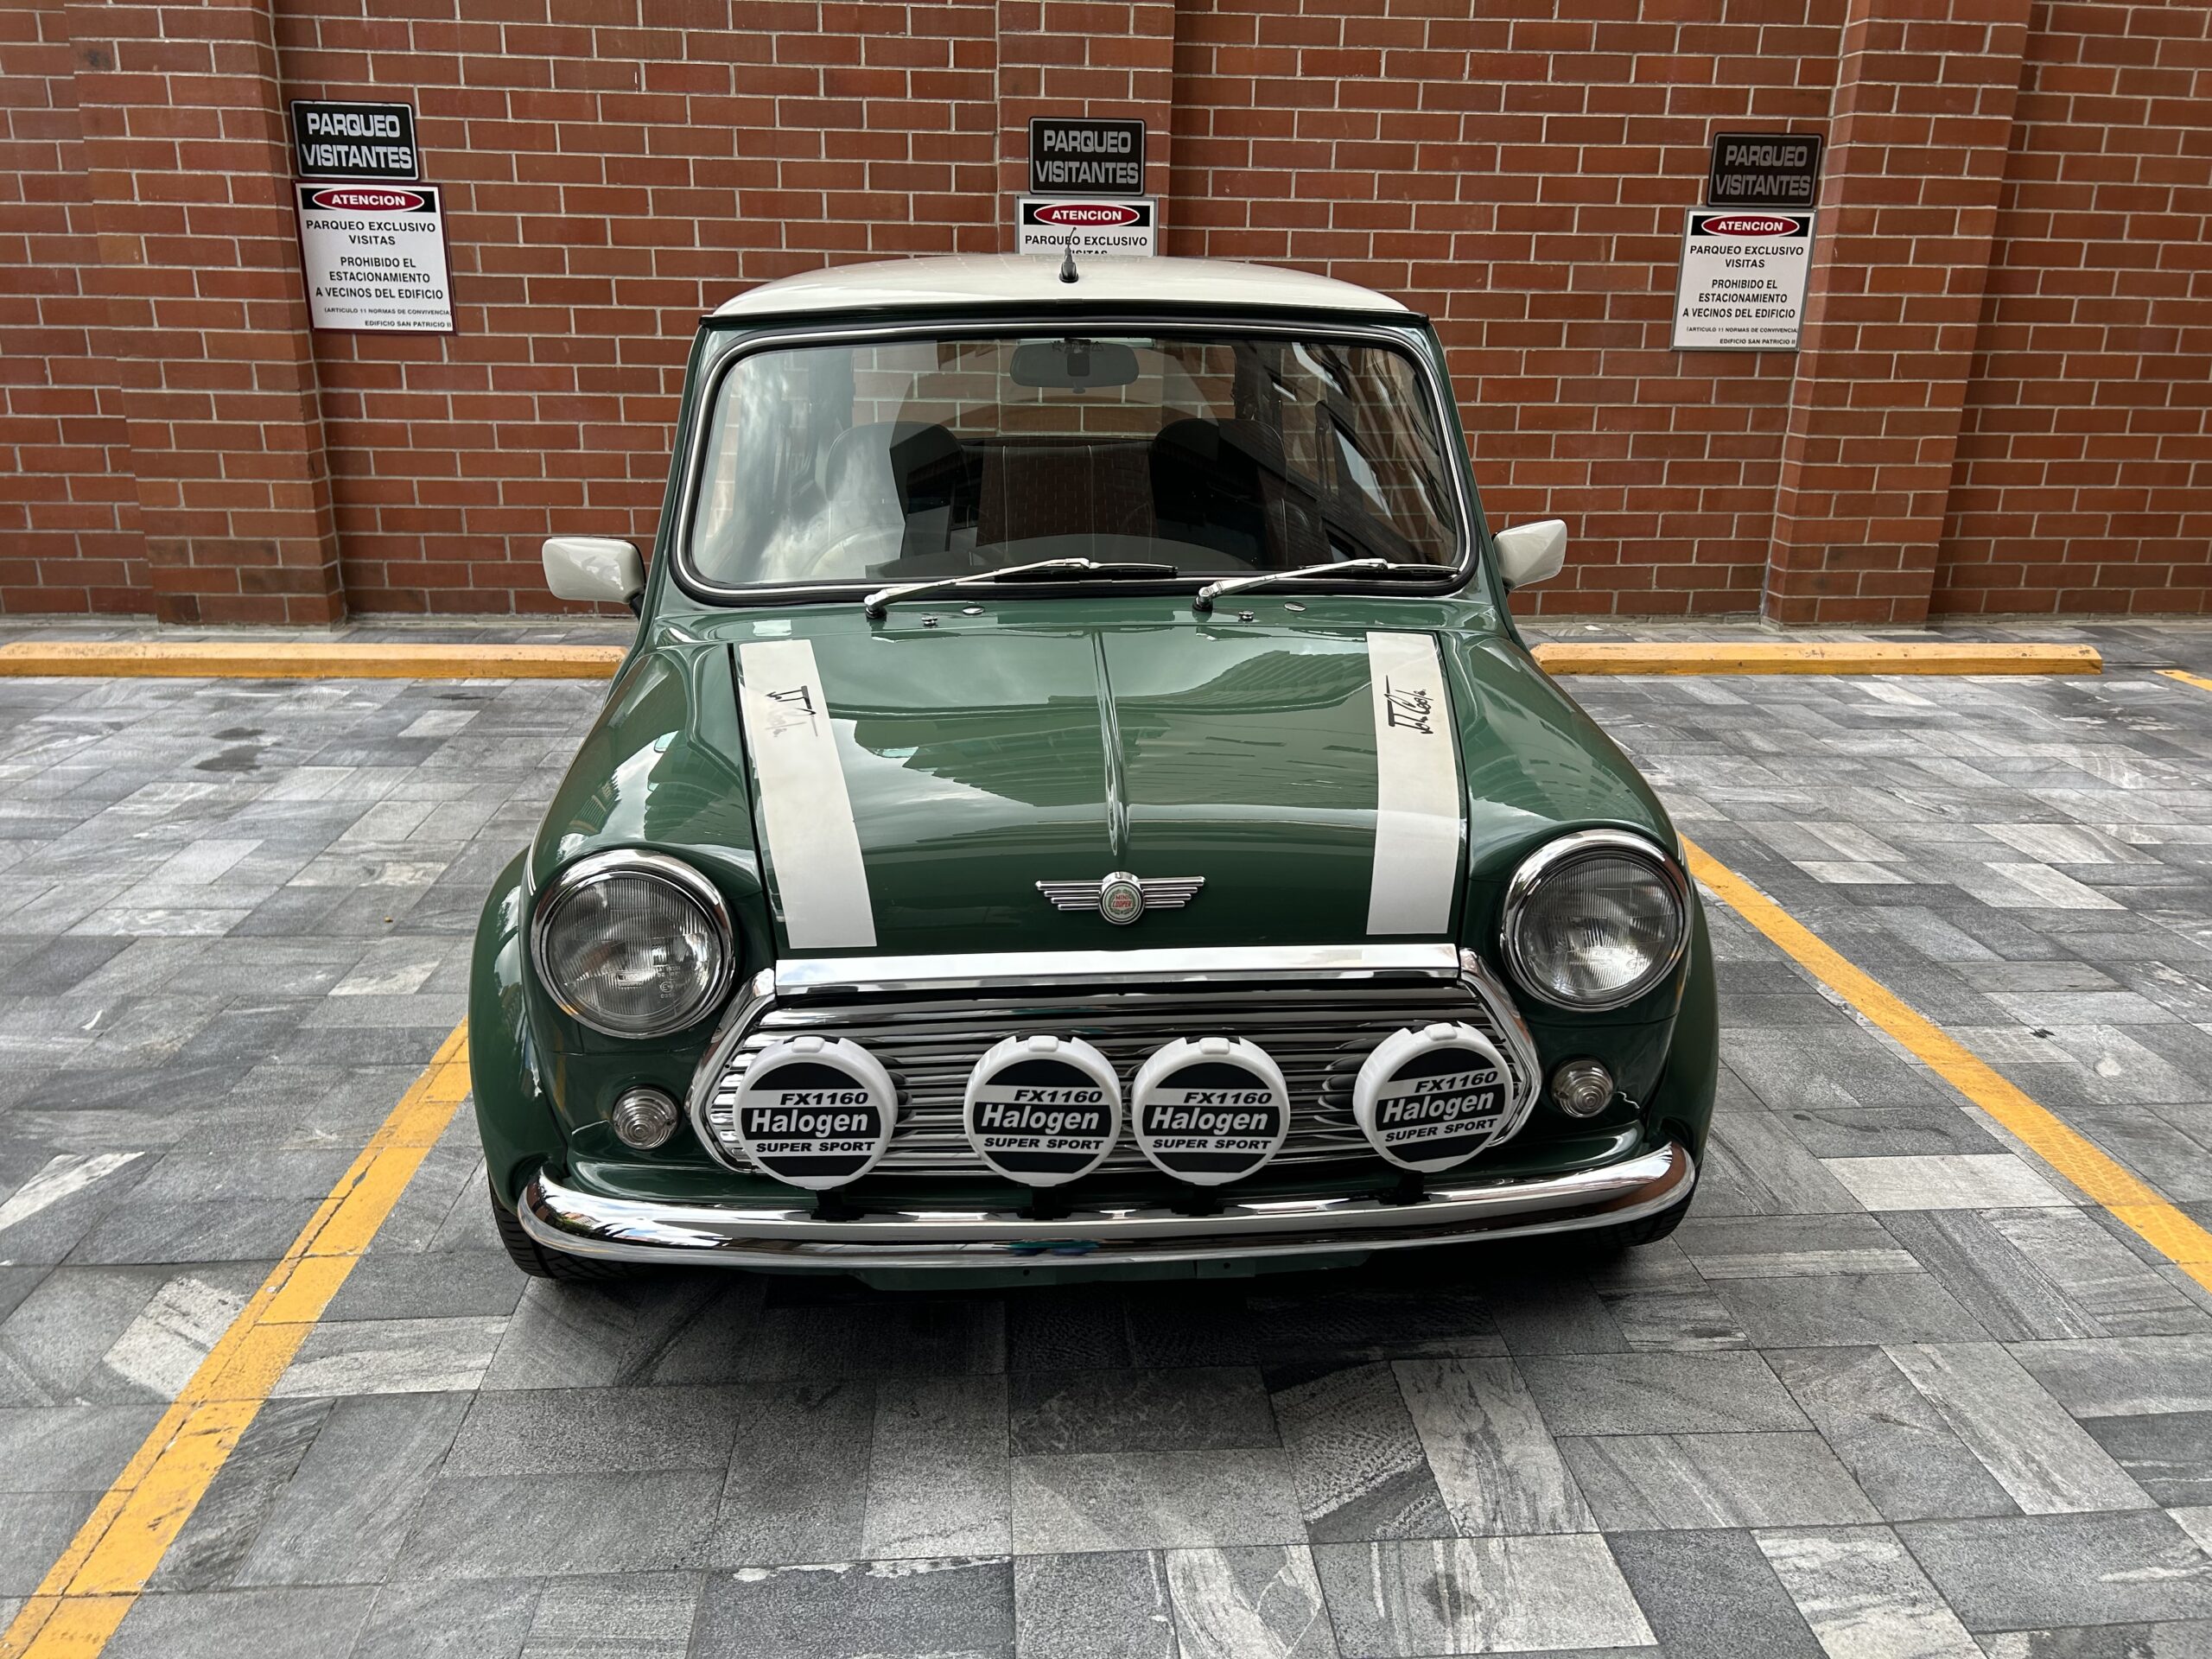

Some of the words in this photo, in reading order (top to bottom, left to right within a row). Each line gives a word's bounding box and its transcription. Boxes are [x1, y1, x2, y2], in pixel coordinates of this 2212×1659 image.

[307, 112, 400, 137] PARQUEO
[1044, 130, 1131, 153] PARQUEO
[302, 143, 412, 169] VISITANTES
[1725, 145, 1807, 167] PARQUEO
[1036, 161, 1139, 184] VISITANTES
[1715, 174, 1810, 196] VISITANTES
[332, 194, 405, 207] ATENCION
[1052, 210, 1122, 220] ATENCION
[306, 219, 365, 231] PARQUEO
[369, 221, 435, 232] EXCLUSIVO
[1718, 221, 1783, 232] ATENCION
[348, 235, 396, 245] VISITAS
[1025, 235, 1080, 245] PARQUEO
[1084, 236, 1147, 246] EXCLUSIVO
[1690, 245, 1741, 255] PARQUEO
[1745, 246, 1803, 256] EXCLUSIVO
[340, 257, 400, 268] PROHIBIDO
[403, 257, 416, 268] EL
[1725, 258, 1765, 268] VISITAS
[329, 270, 430, 283] ESTACIONAMIENTO
[1712, 279, 1764, 289] PROHIBIDO
[1767, 280, 1778, 289] EL
[315, 287, 323, 297] A
[326, 287, 372, 298] VECINOS
[375, 289, 396, 299] DEL
[398, 289, 443, 300] EDIFICIO
[1699, 293, 1788, 303] ESTACIONAMIENTO
[1682, 308, 1689, 317] A
[1692, 308, 1732, 318] VECINOS
[1734, 308, 1752, 318] DEL
[1755, 309, 1796, 319] EDIFICIO
[1414, 1071, 1498, 1093] FX1160
[780, 1092, 868, 1105] FX1160
[1014, 1090, 1103, 1103] FX1160
[1184, 1092, 1272, 1104] FX1160
[1382, 1091, 1494, 1123] Halogen
[750, 1109, 868, 1138] Halogen
[981, 1104, 1099, 1135] Halogen
[1150, 1106, 1268, 1135] Halogen
[1385, 1127, 1438, 1142] SUPER
[1444, 1118, 1497, 1134] SPORT
[756, 1142, 812, 1153] SUPER
[819, 1141, 875, 1152] SPORT
[984, 1137, 1040, 1148] SUPER
[1046, 1139, 1103, 1150] SPORT
[1153, 1139, 1208, 1148] SUPER
[1215, 1140, 1271, 1149] SPORT
